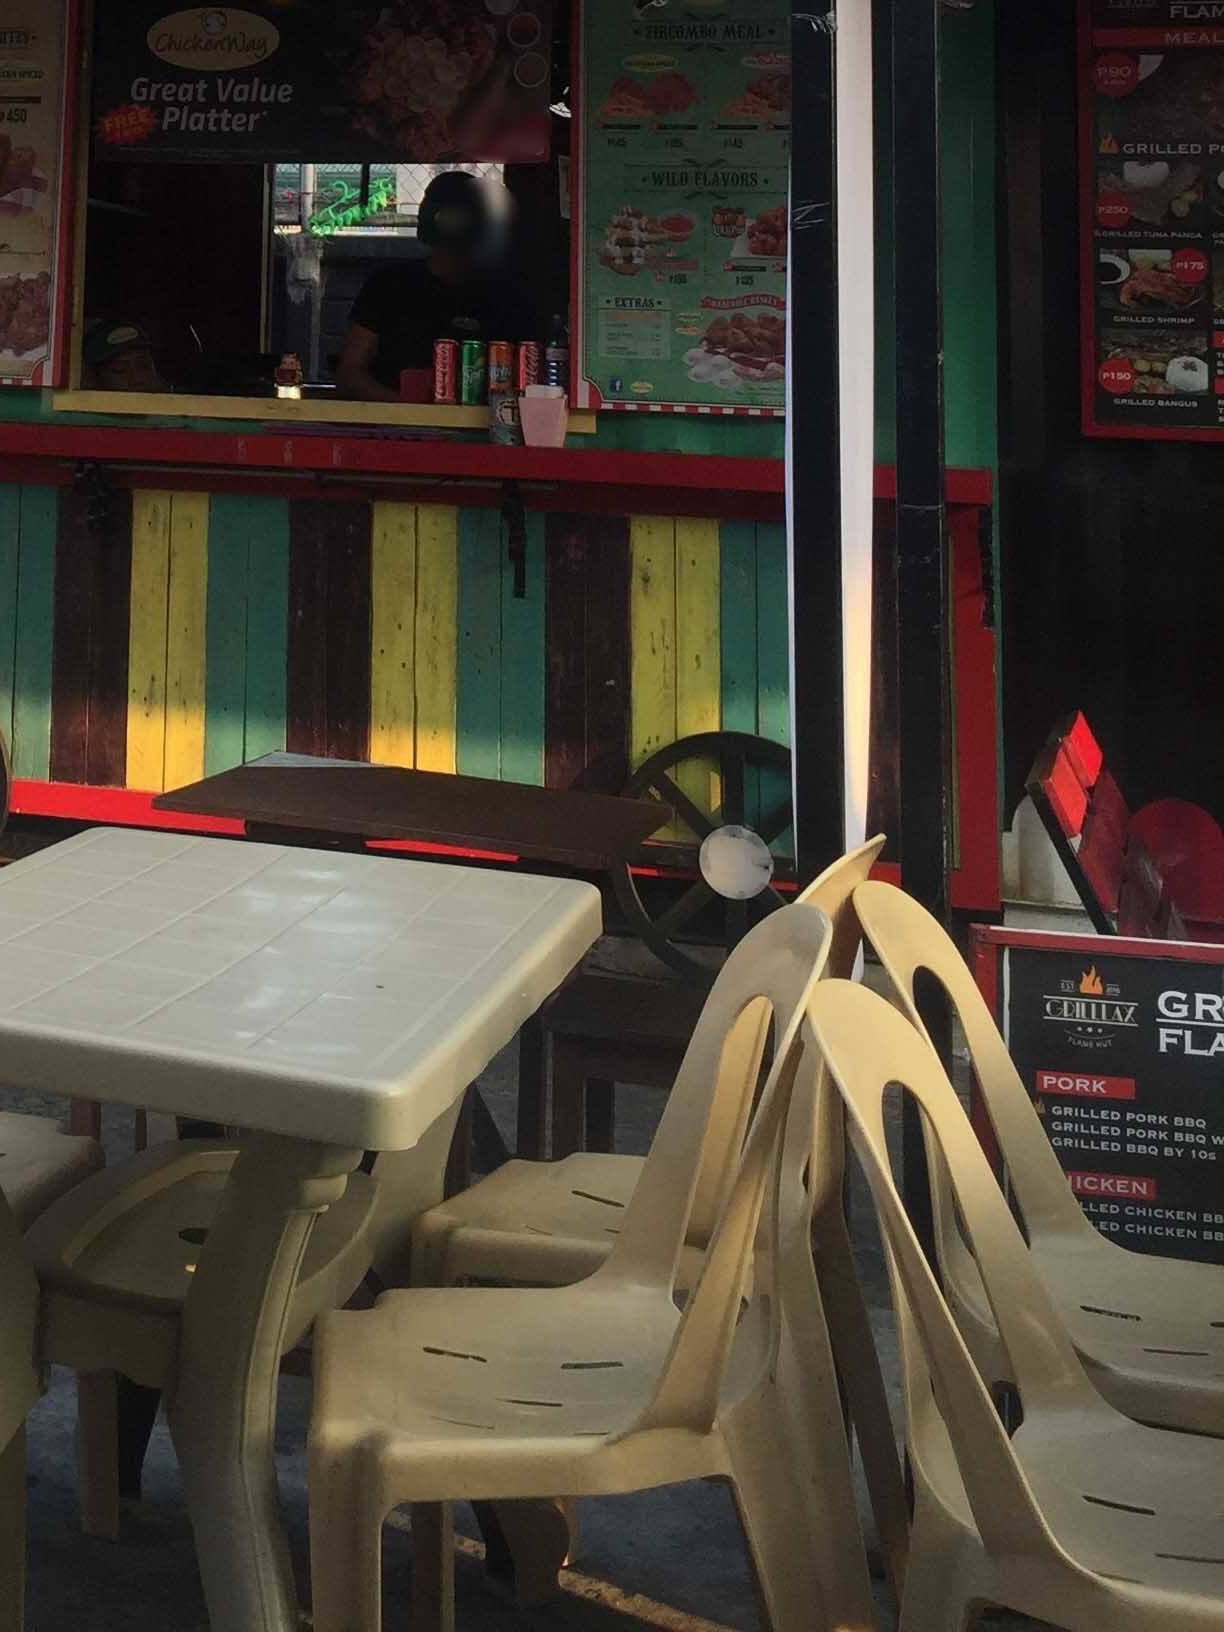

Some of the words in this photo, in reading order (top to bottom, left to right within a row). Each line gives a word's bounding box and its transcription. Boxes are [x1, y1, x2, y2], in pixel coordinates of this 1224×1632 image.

[130, 76, 209, 103] Great
[216, 76, 296, 104] Value
[1123, 143, 1203, 155] GRILLED
[694, 171, 759, 187] FLAVORS
[1042, 1075, 1107, 1094] PORK
[1051, 1105, 1121, 1121] GRILLED
[1126, 1112, 1169, 1125] PORK
[1174, 1116, 1207, 1129] BBQ
[1051, 1121, 1121, 1137] GRILLED
[1126, 1128, 1169, 1141] PORK
[1174, 1132, 1207, 1145] BBQ
[1051, 1136, 1121, 1152] GRILLED
[1126, 1143, 1159, 1156] BBQ
[1164, 1147, 1184, 1158] BY
[1068, 1175, 1148, 1195] ICKEN
[1079, 1202, 1120, 1214] LLED
[1124, 1205, 1197, 1221] CHICKEN
[1202, 1212, 1224, 1224] BB
[1124, 1222, 1197, 1239] CHICKEN
[1202, 1230, 1224, 1242] BB
